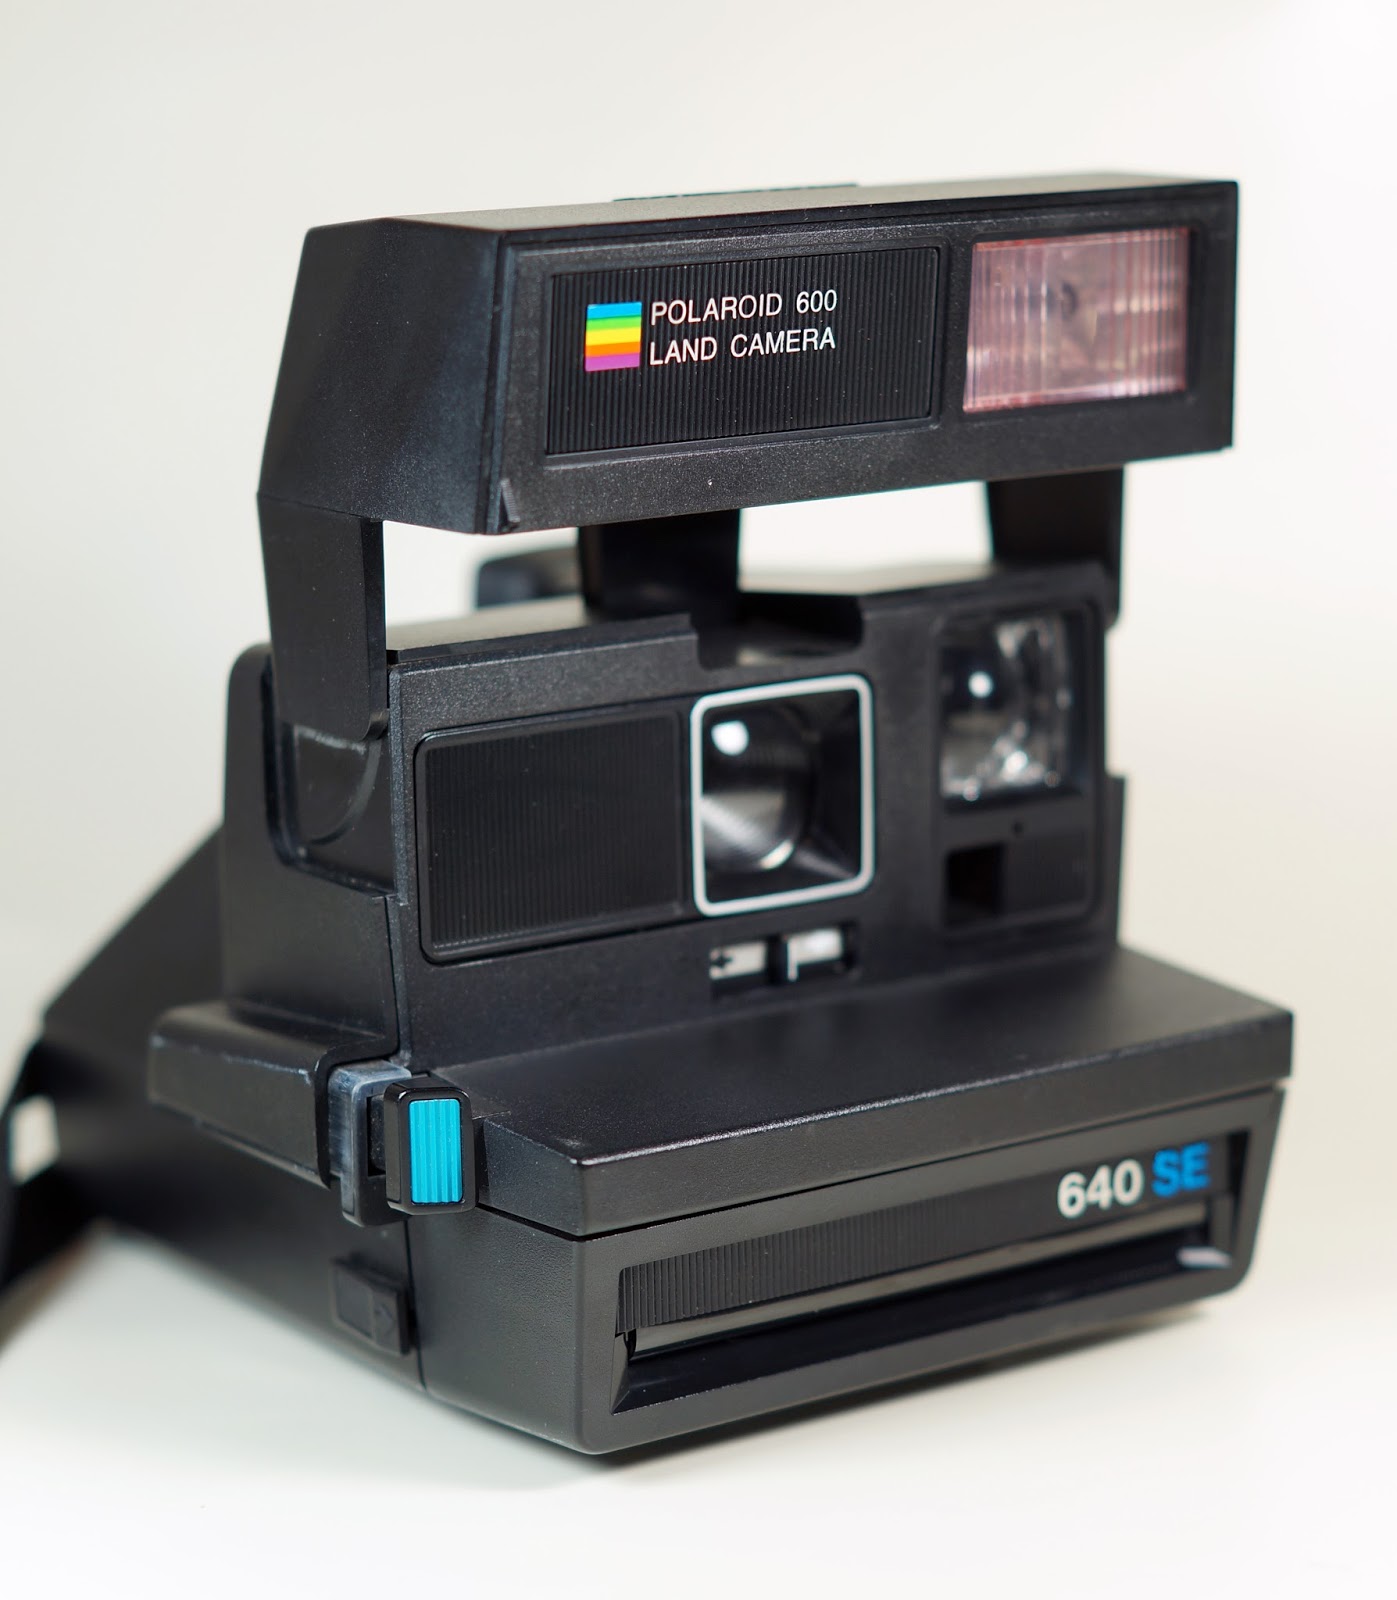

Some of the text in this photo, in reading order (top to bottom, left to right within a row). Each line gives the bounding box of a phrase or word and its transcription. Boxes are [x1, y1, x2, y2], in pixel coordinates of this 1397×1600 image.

[650, 288, 838, 326] POLAROID 600
[649, 326, 836, 366] LAND CAMERA
[1057, 1142, 1210, 1218] 640 SE
